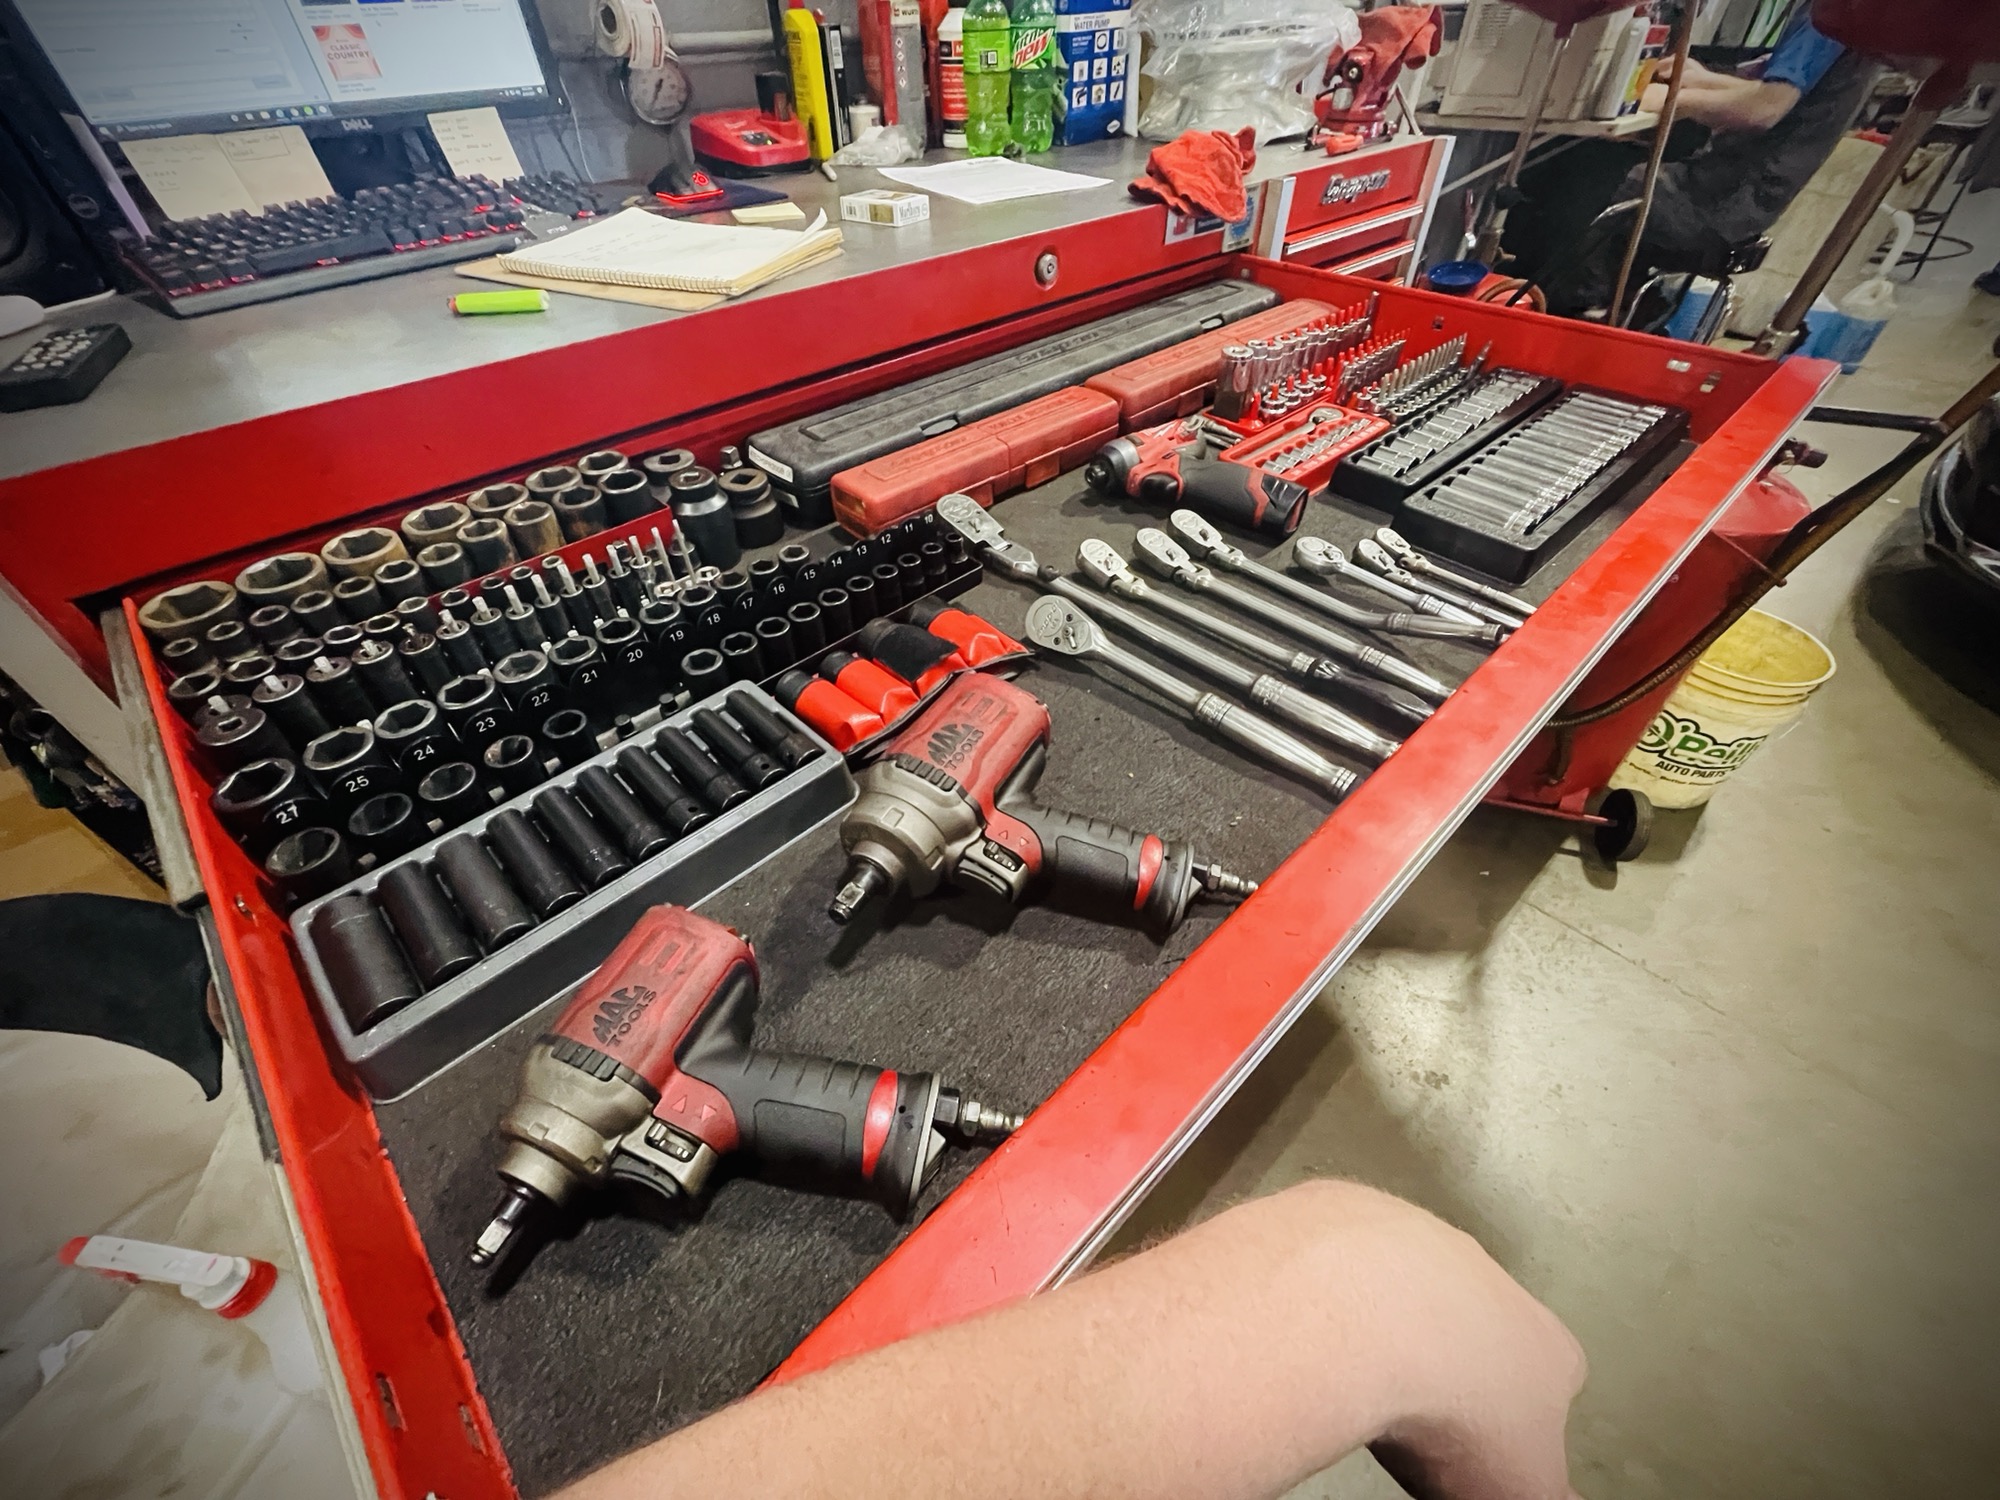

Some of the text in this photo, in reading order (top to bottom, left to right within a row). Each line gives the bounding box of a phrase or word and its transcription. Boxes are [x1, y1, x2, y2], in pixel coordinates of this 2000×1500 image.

[1074, 18, 1110, 30] WATER PUMP
[330, 43, 362, 51] CLASSIC
[327, 50, 370, 60] COUNTRY
[341, 118, 373, 131] DELL
[924, 514, 934, 524] 10
[904, 523, 914, 533] 11
[880, 533, 892, 545] 12
[856, 545, 868, 556] 13
[831, 556, 843, 567] 14
[803, 569, 816, 580] 15
[773, 583, 786, 595] 16
[742, 597, 753, 610] 17
[707, 613, 721, 626] 18
[669, 630, 685, 642] 19
[627, 648, 643, 663] 20
[582, 669, 599, 684] 21
[531, 692, 551, 707] 22
[475, 716, 496, 732] 23
[927, 723, 975, 766] MAC
[944, 729, 984, 770] TOOLS
[413, 744, 435, 761] 24
[1655, 761, 1725, 779] AUTO PARTS
[345, 775, 370, 792] 25
[276, 804, 299, 824] 27
[593, 985, 648, 1044] MAC
[606, 990, 657, 1047] TOOLS
